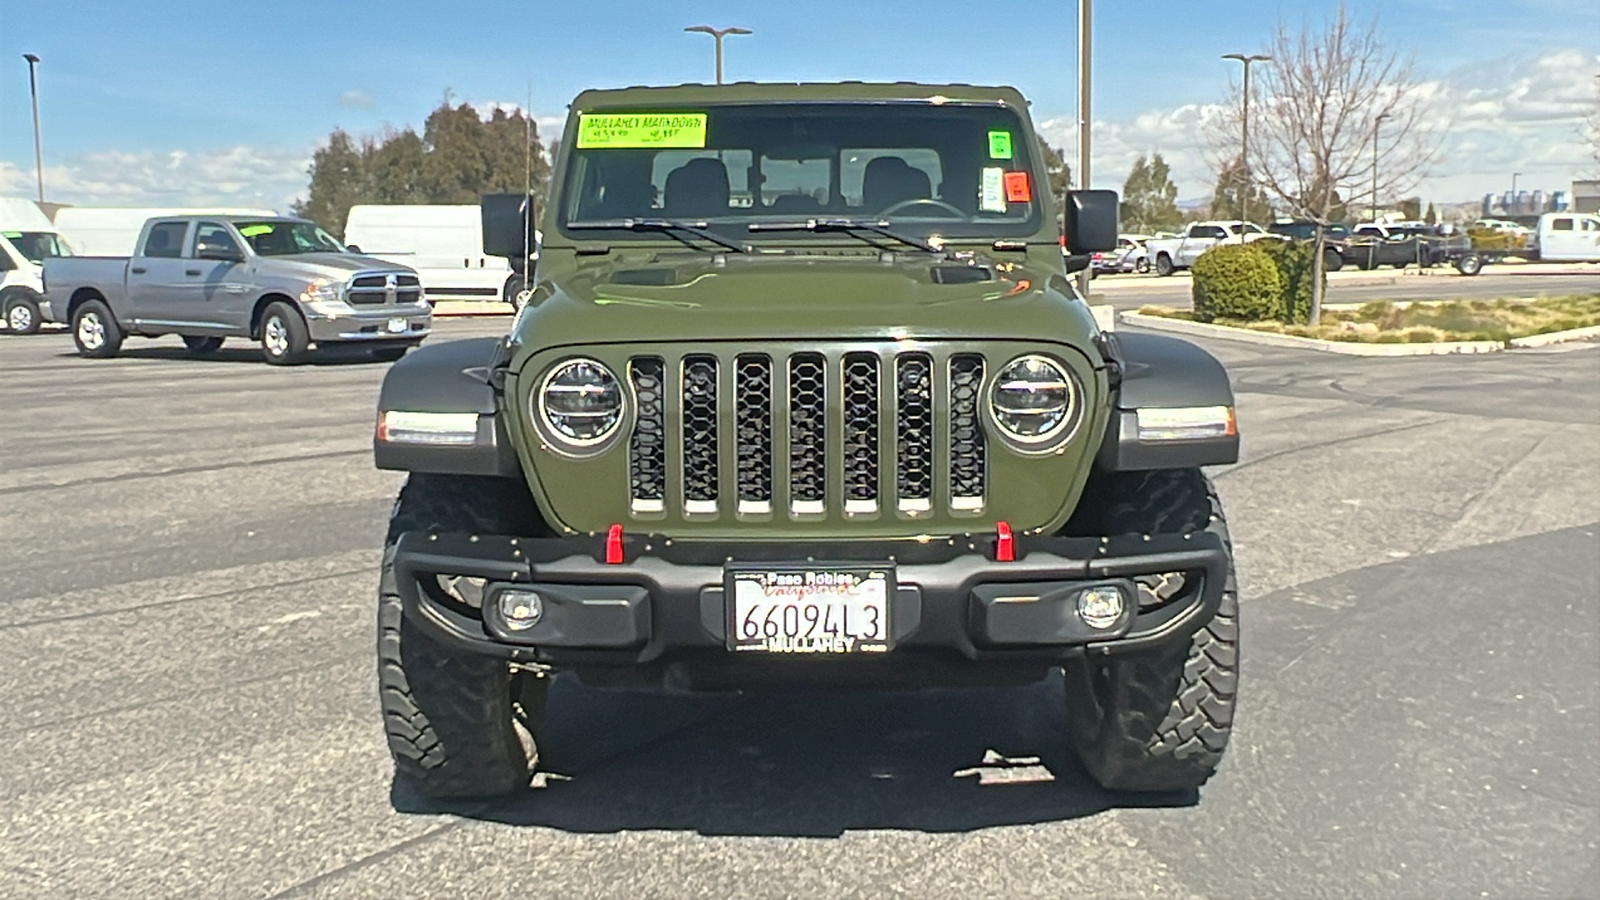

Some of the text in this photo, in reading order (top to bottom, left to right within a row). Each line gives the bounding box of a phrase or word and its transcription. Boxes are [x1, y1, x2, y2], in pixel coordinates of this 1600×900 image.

[767, 571, 802, 586] Paso
[806, 571, 854, 586] Robles
[743, 604, 879, 638] 66094L3
[768, 637, 856, 653] MULLAHEY
